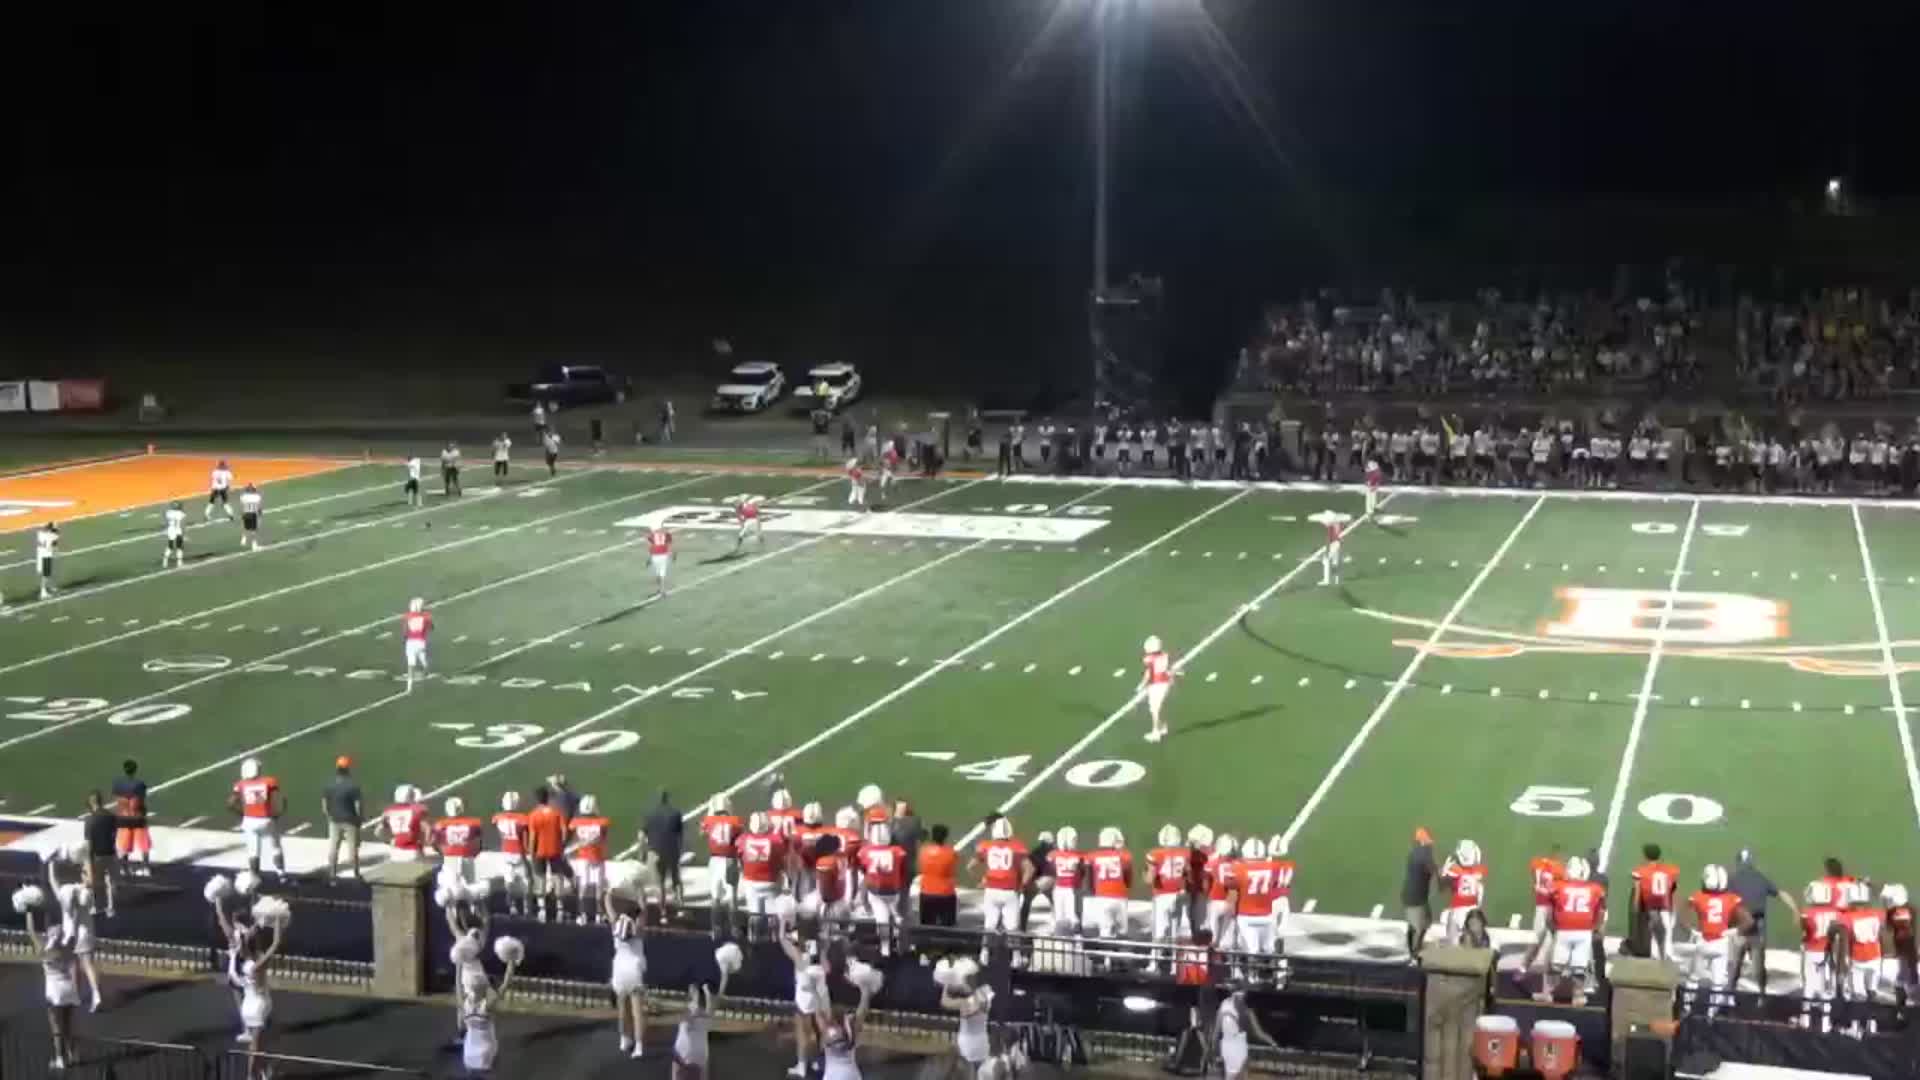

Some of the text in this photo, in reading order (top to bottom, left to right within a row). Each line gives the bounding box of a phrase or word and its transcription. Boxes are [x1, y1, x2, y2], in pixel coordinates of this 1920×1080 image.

[1537, 586, 1790, 643] B
[953, 754, 1146, 788] 40
[1509, 786, 1723, 825] 50
[1247, 869, 1273, 895] 77
[1564, 885, 1591, 913] 72
[1705, 898, 1724, 924] 2
